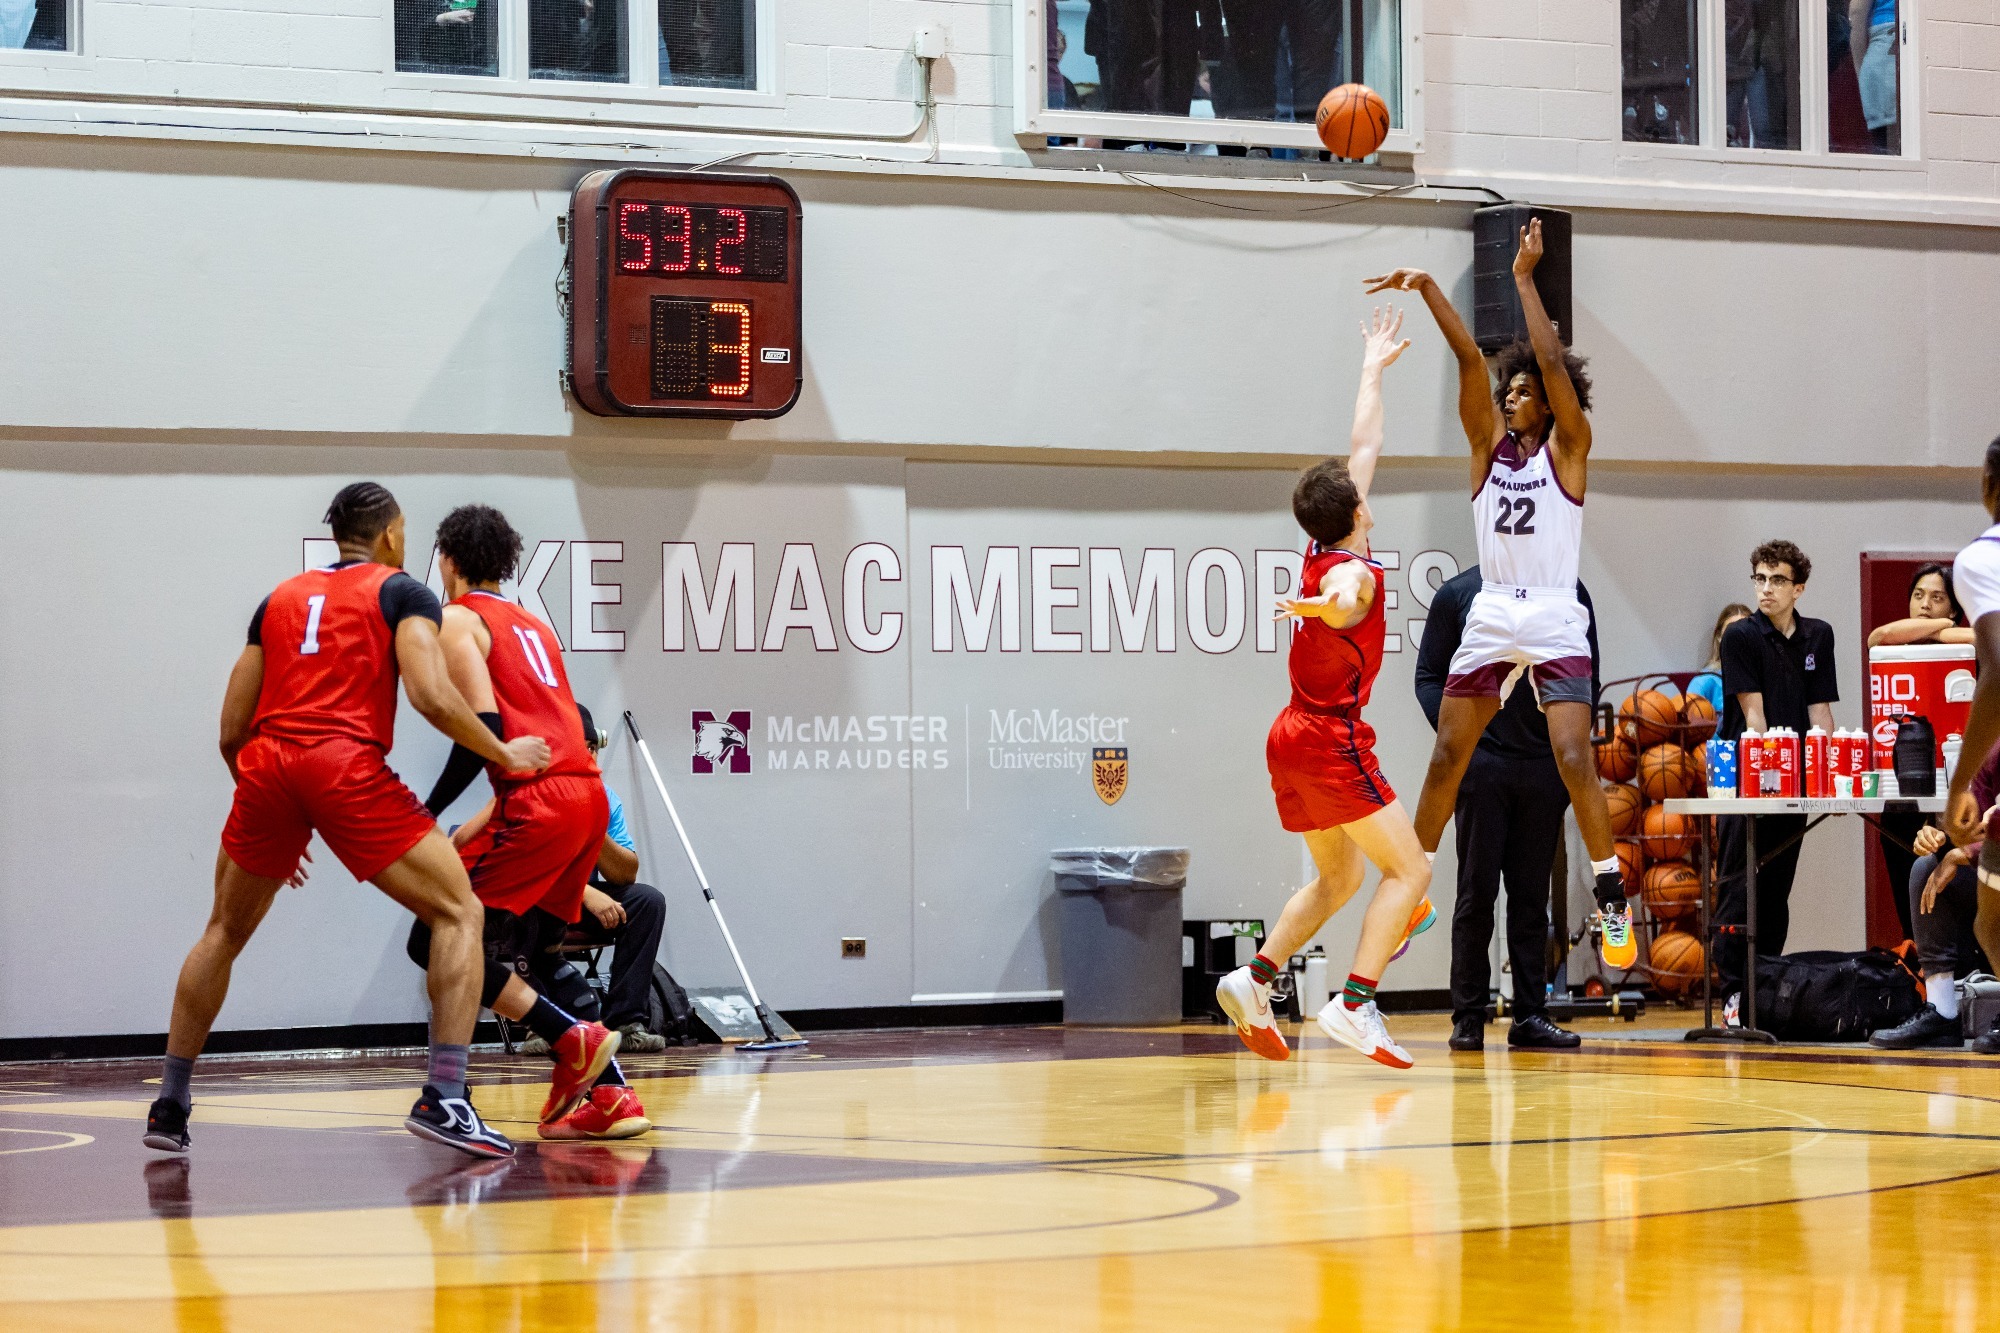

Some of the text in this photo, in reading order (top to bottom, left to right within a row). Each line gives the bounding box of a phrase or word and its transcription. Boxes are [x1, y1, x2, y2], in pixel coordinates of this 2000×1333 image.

[711, 303, 750, 396] 3
[1494, 496, 1536, 535] 22
[302, 537, 1460, 654] KE MAC MEMORES
[300, 594, 326, 655] 1
[512, 624, 559, 689] 11
[767, 715, 949, 743] McMASTER
[987, 708, 1129, 745] McMaster
[767, 749, 949, 770] MARAUDERS
[987, 746, 1088, 775] University
